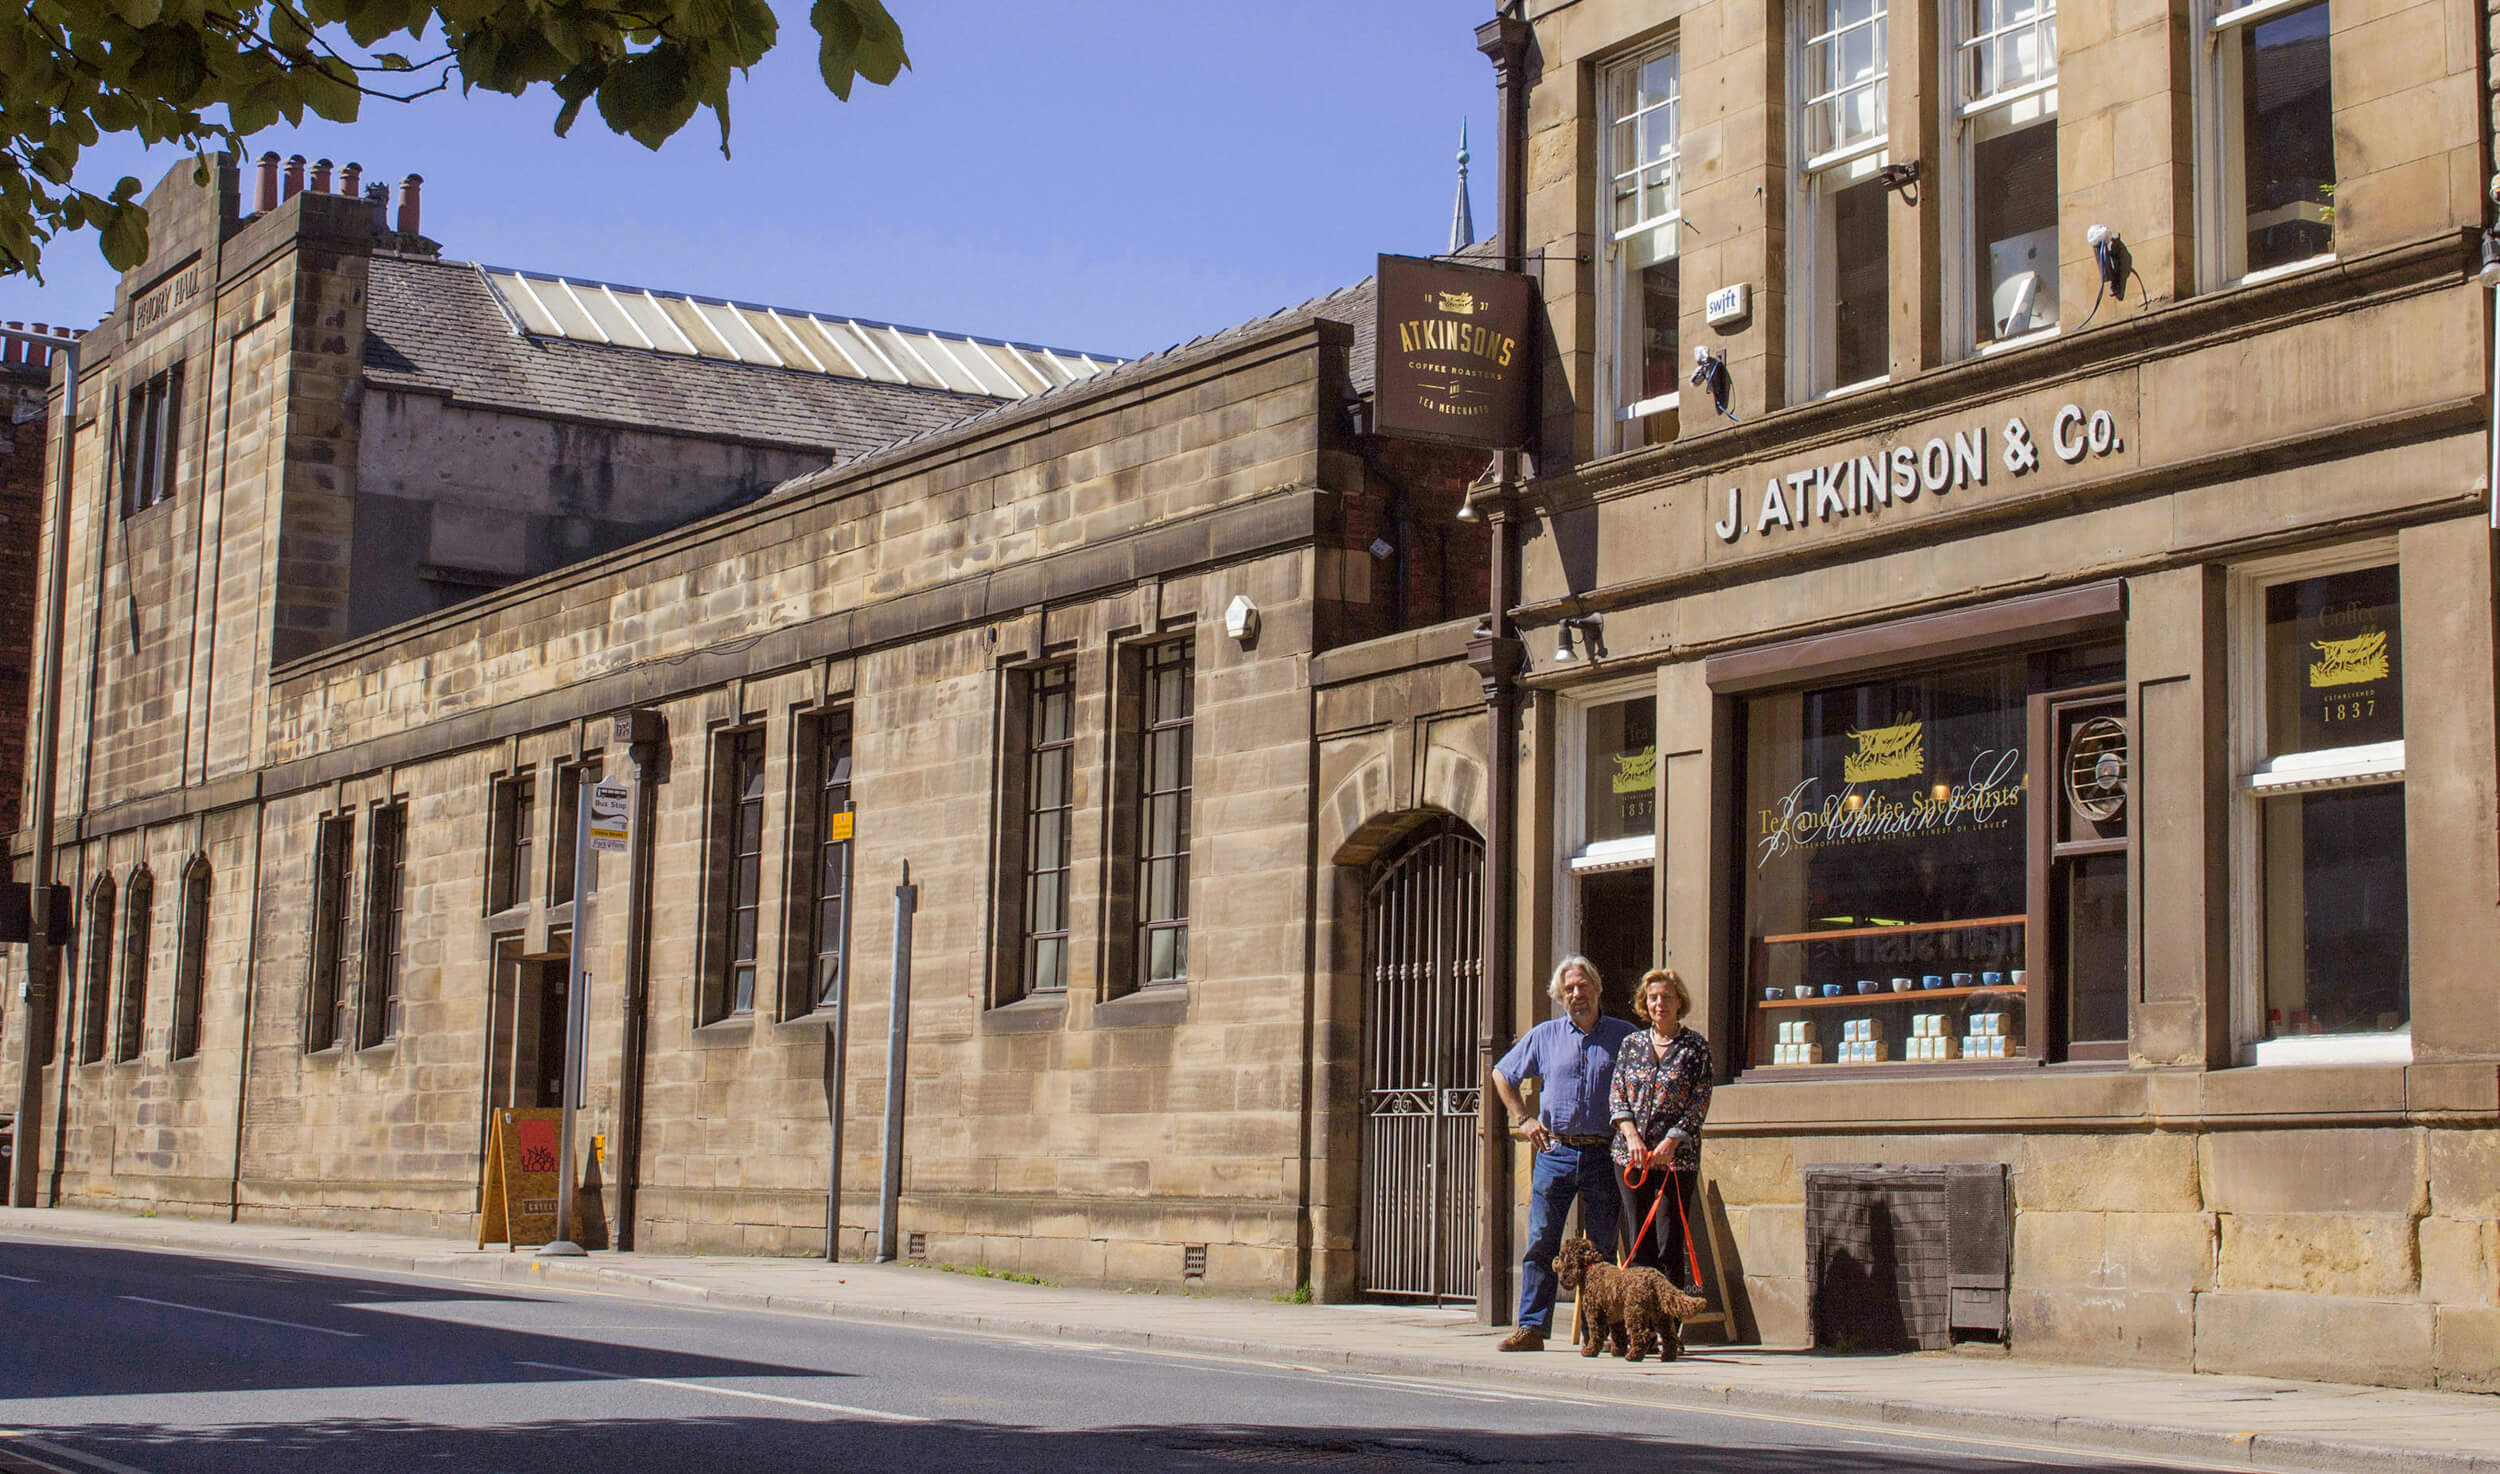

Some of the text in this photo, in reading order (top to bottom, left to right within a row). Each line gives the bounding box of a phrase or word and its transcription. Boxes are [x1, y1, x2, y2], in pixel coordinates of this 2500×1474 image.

[136, 267, 200, 331] PRIORY HALL
[1709, 289, 1736, 314] swift
[1399, 319, 1515, 367] ATKINSONS
[1408, 361, 1503, 381] COFFEE ROASTERS
[1418, 395, 1489, 416] TEA MERCHANTS
[1715, 404, 2125, 544] J. ATKINSON & Co.
[2319, 600, 2377, 627] Coffee
[2324, 700, 2375, 722] 1837
[596, 799, 627, 810] Bus Stop
[1620, 801, 1653, 817] 1837
[1758, 783, 2019, 834] Tea and Coffee Specialists
[1902, 830, 1916, 838] THE
[1921, 827, 1951, 837] FINEST
